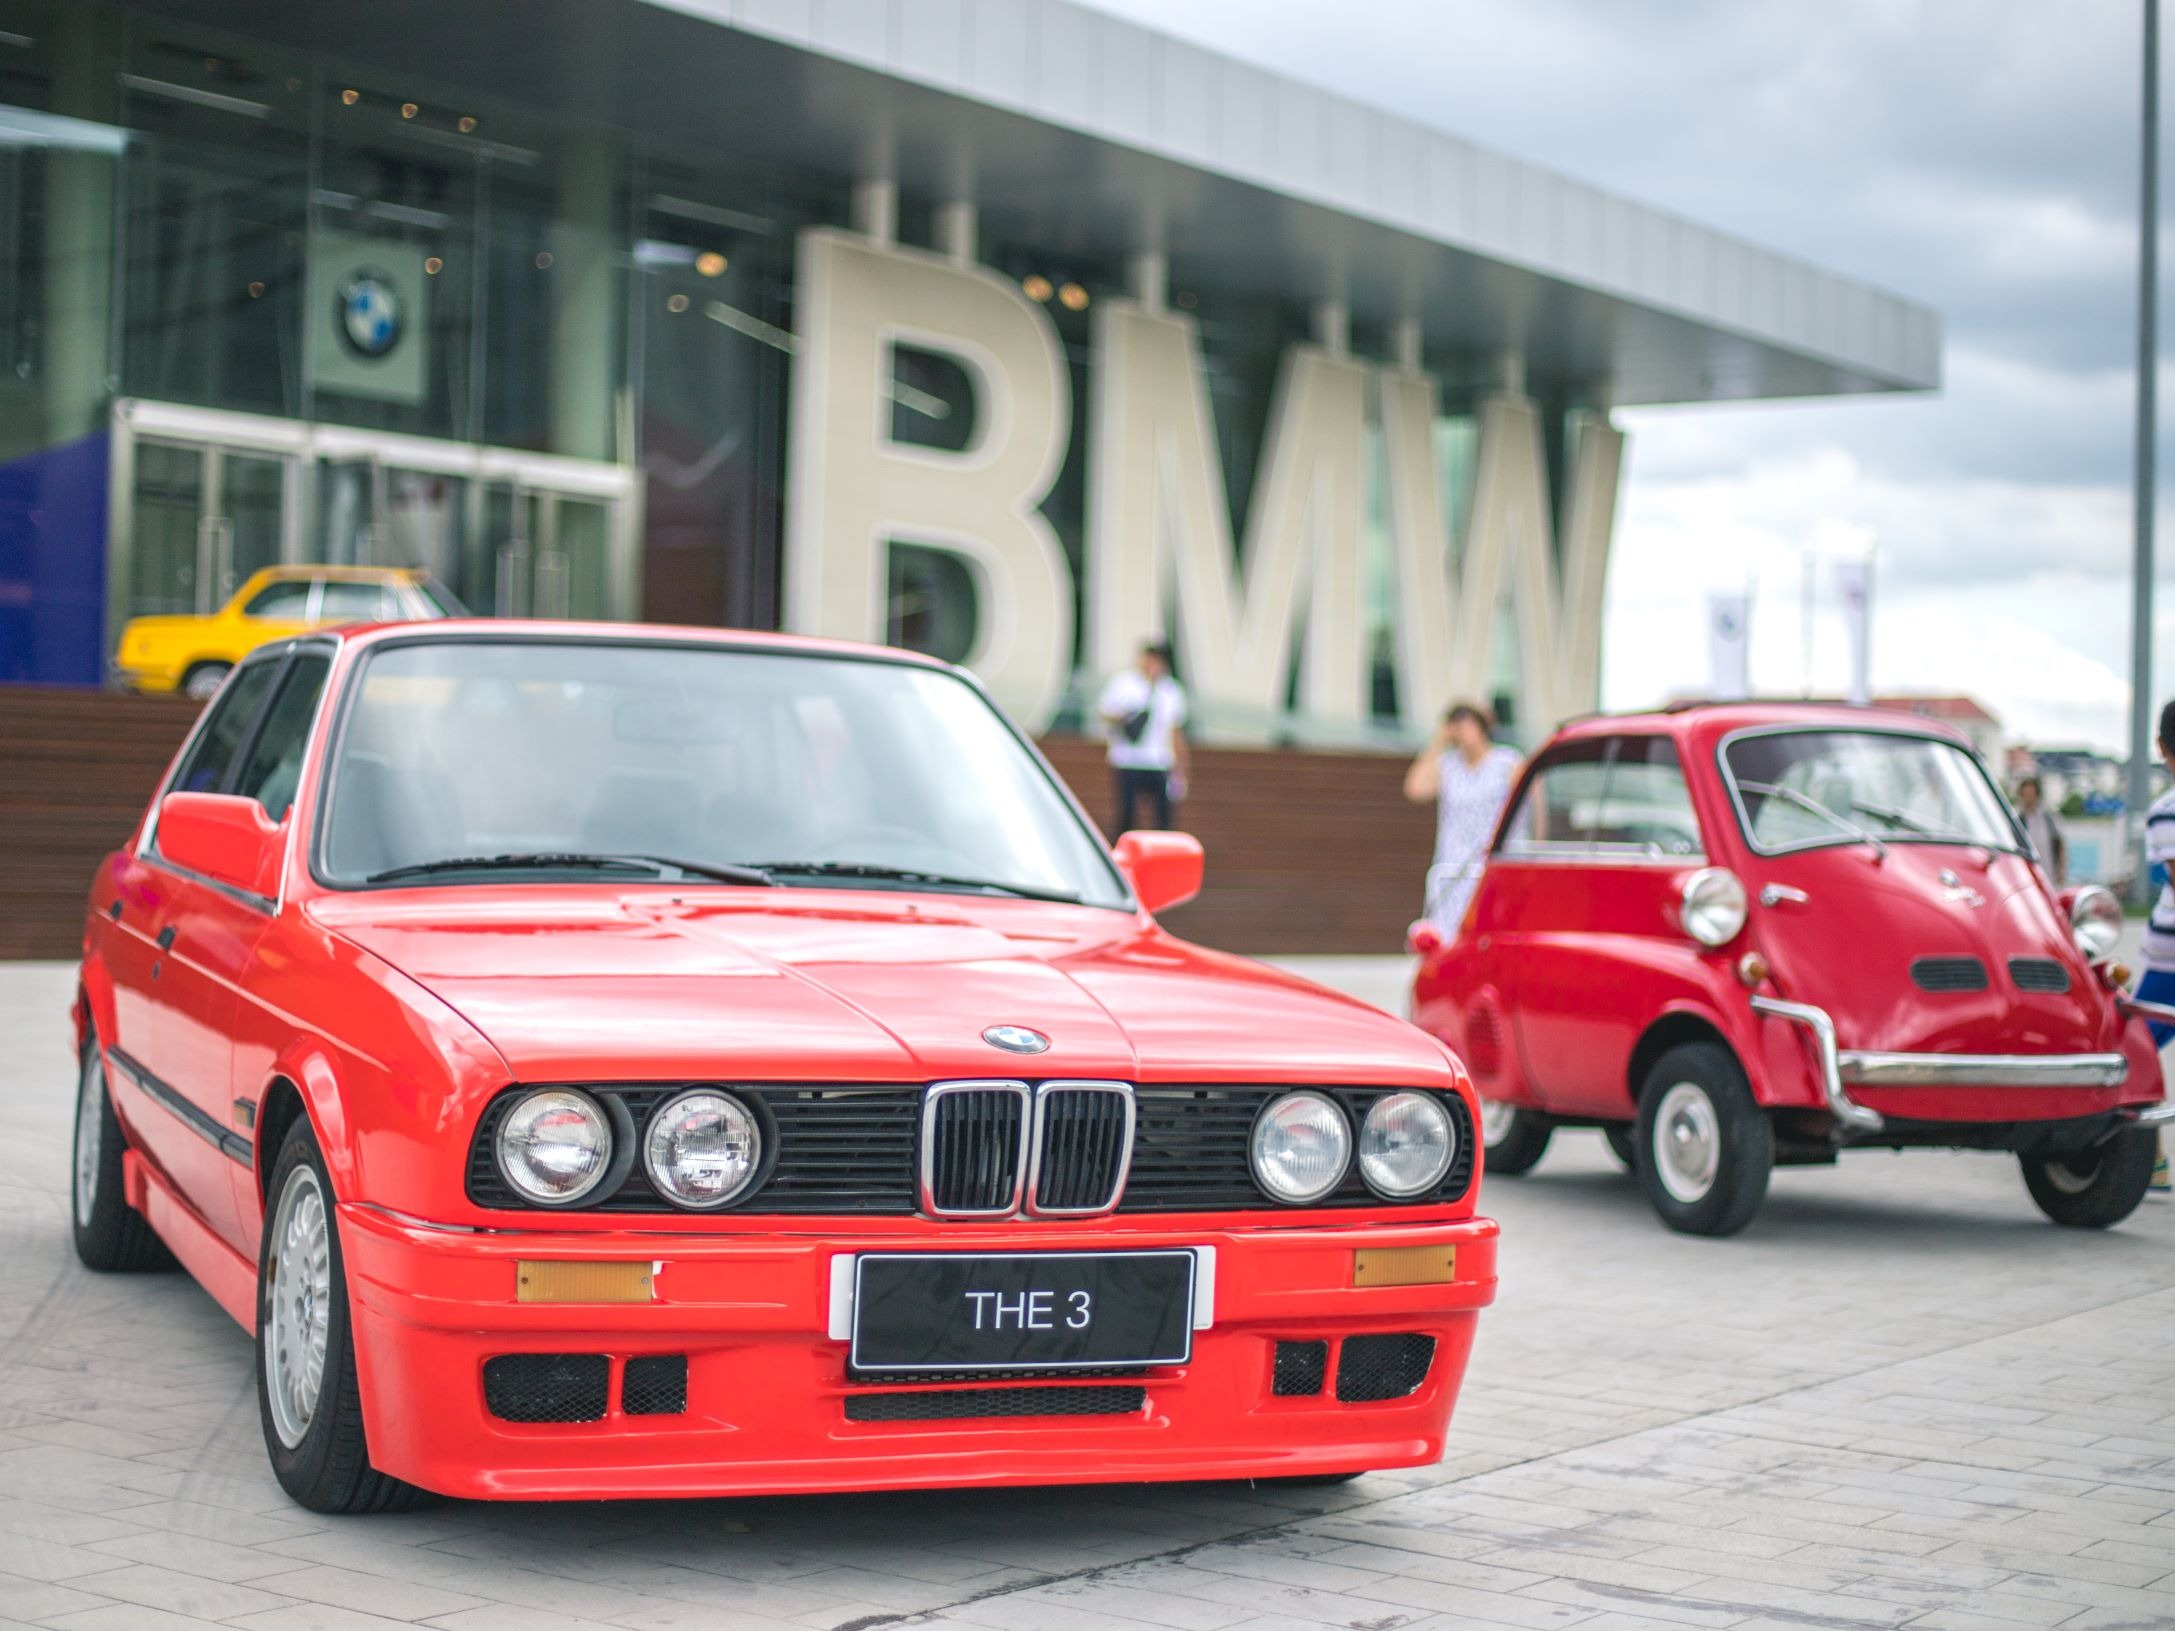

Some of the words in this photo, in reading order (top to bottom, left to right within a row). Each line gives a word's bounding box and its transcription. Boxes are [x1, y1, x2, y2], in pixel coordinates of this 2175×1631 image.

[784, 228, 1626, 750] BMW
[965, 1291, 1054, 1329] THE
[1066, 1290, 1091, 1329] 3
